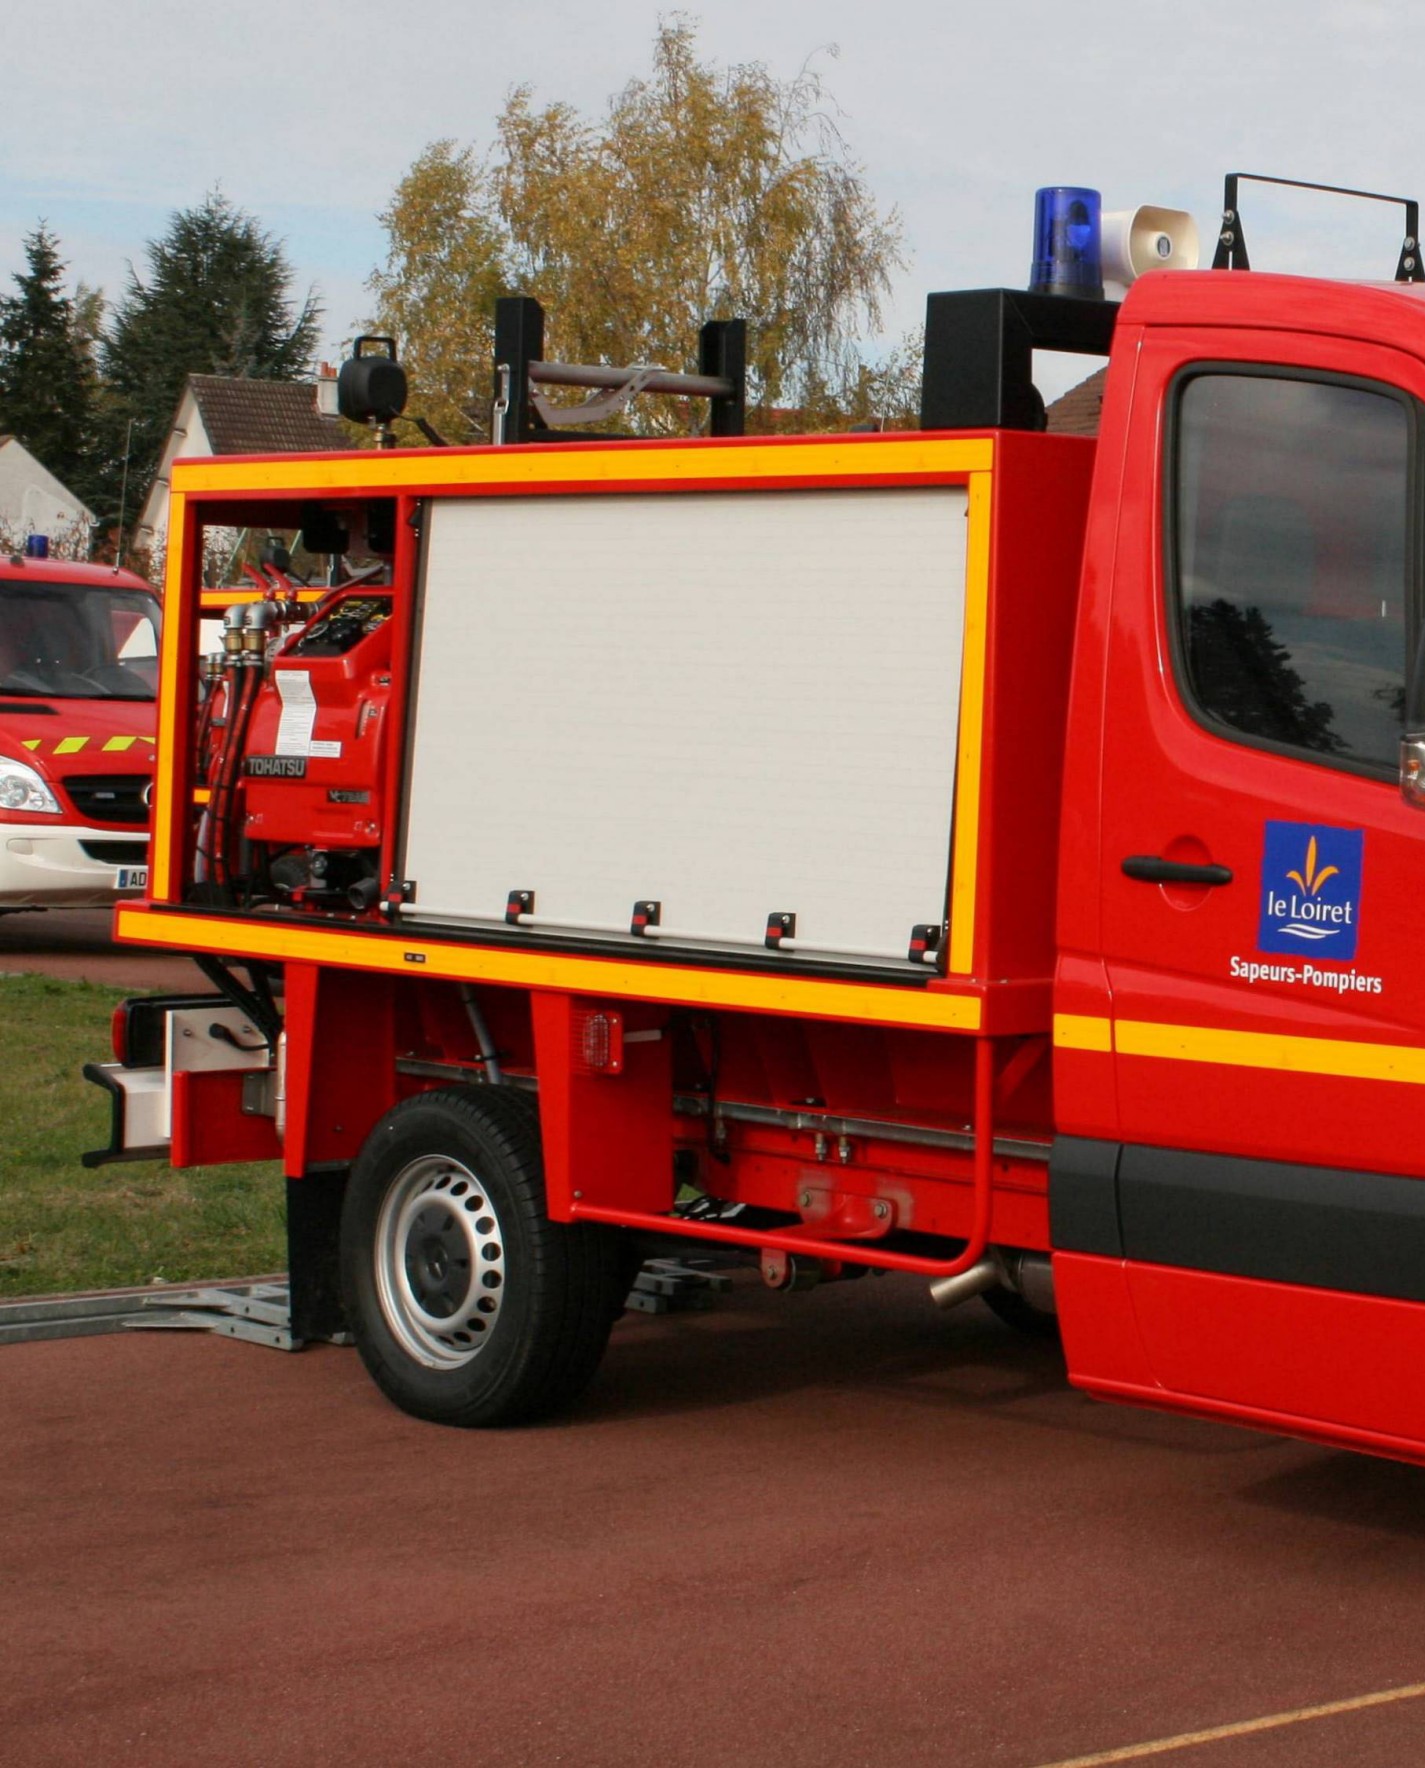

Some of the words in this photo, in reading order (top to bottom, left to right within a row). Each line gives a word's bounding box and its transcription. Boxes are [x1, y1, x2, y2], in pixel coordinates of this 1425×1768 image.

[249, 758, 305, 776] TOHATSU
[1268, 891, 1287, 916] le
[1290, 895, 1352, 924] Loiret
[1230, 955, 1382, 994] Sapeurs-Pompiers
